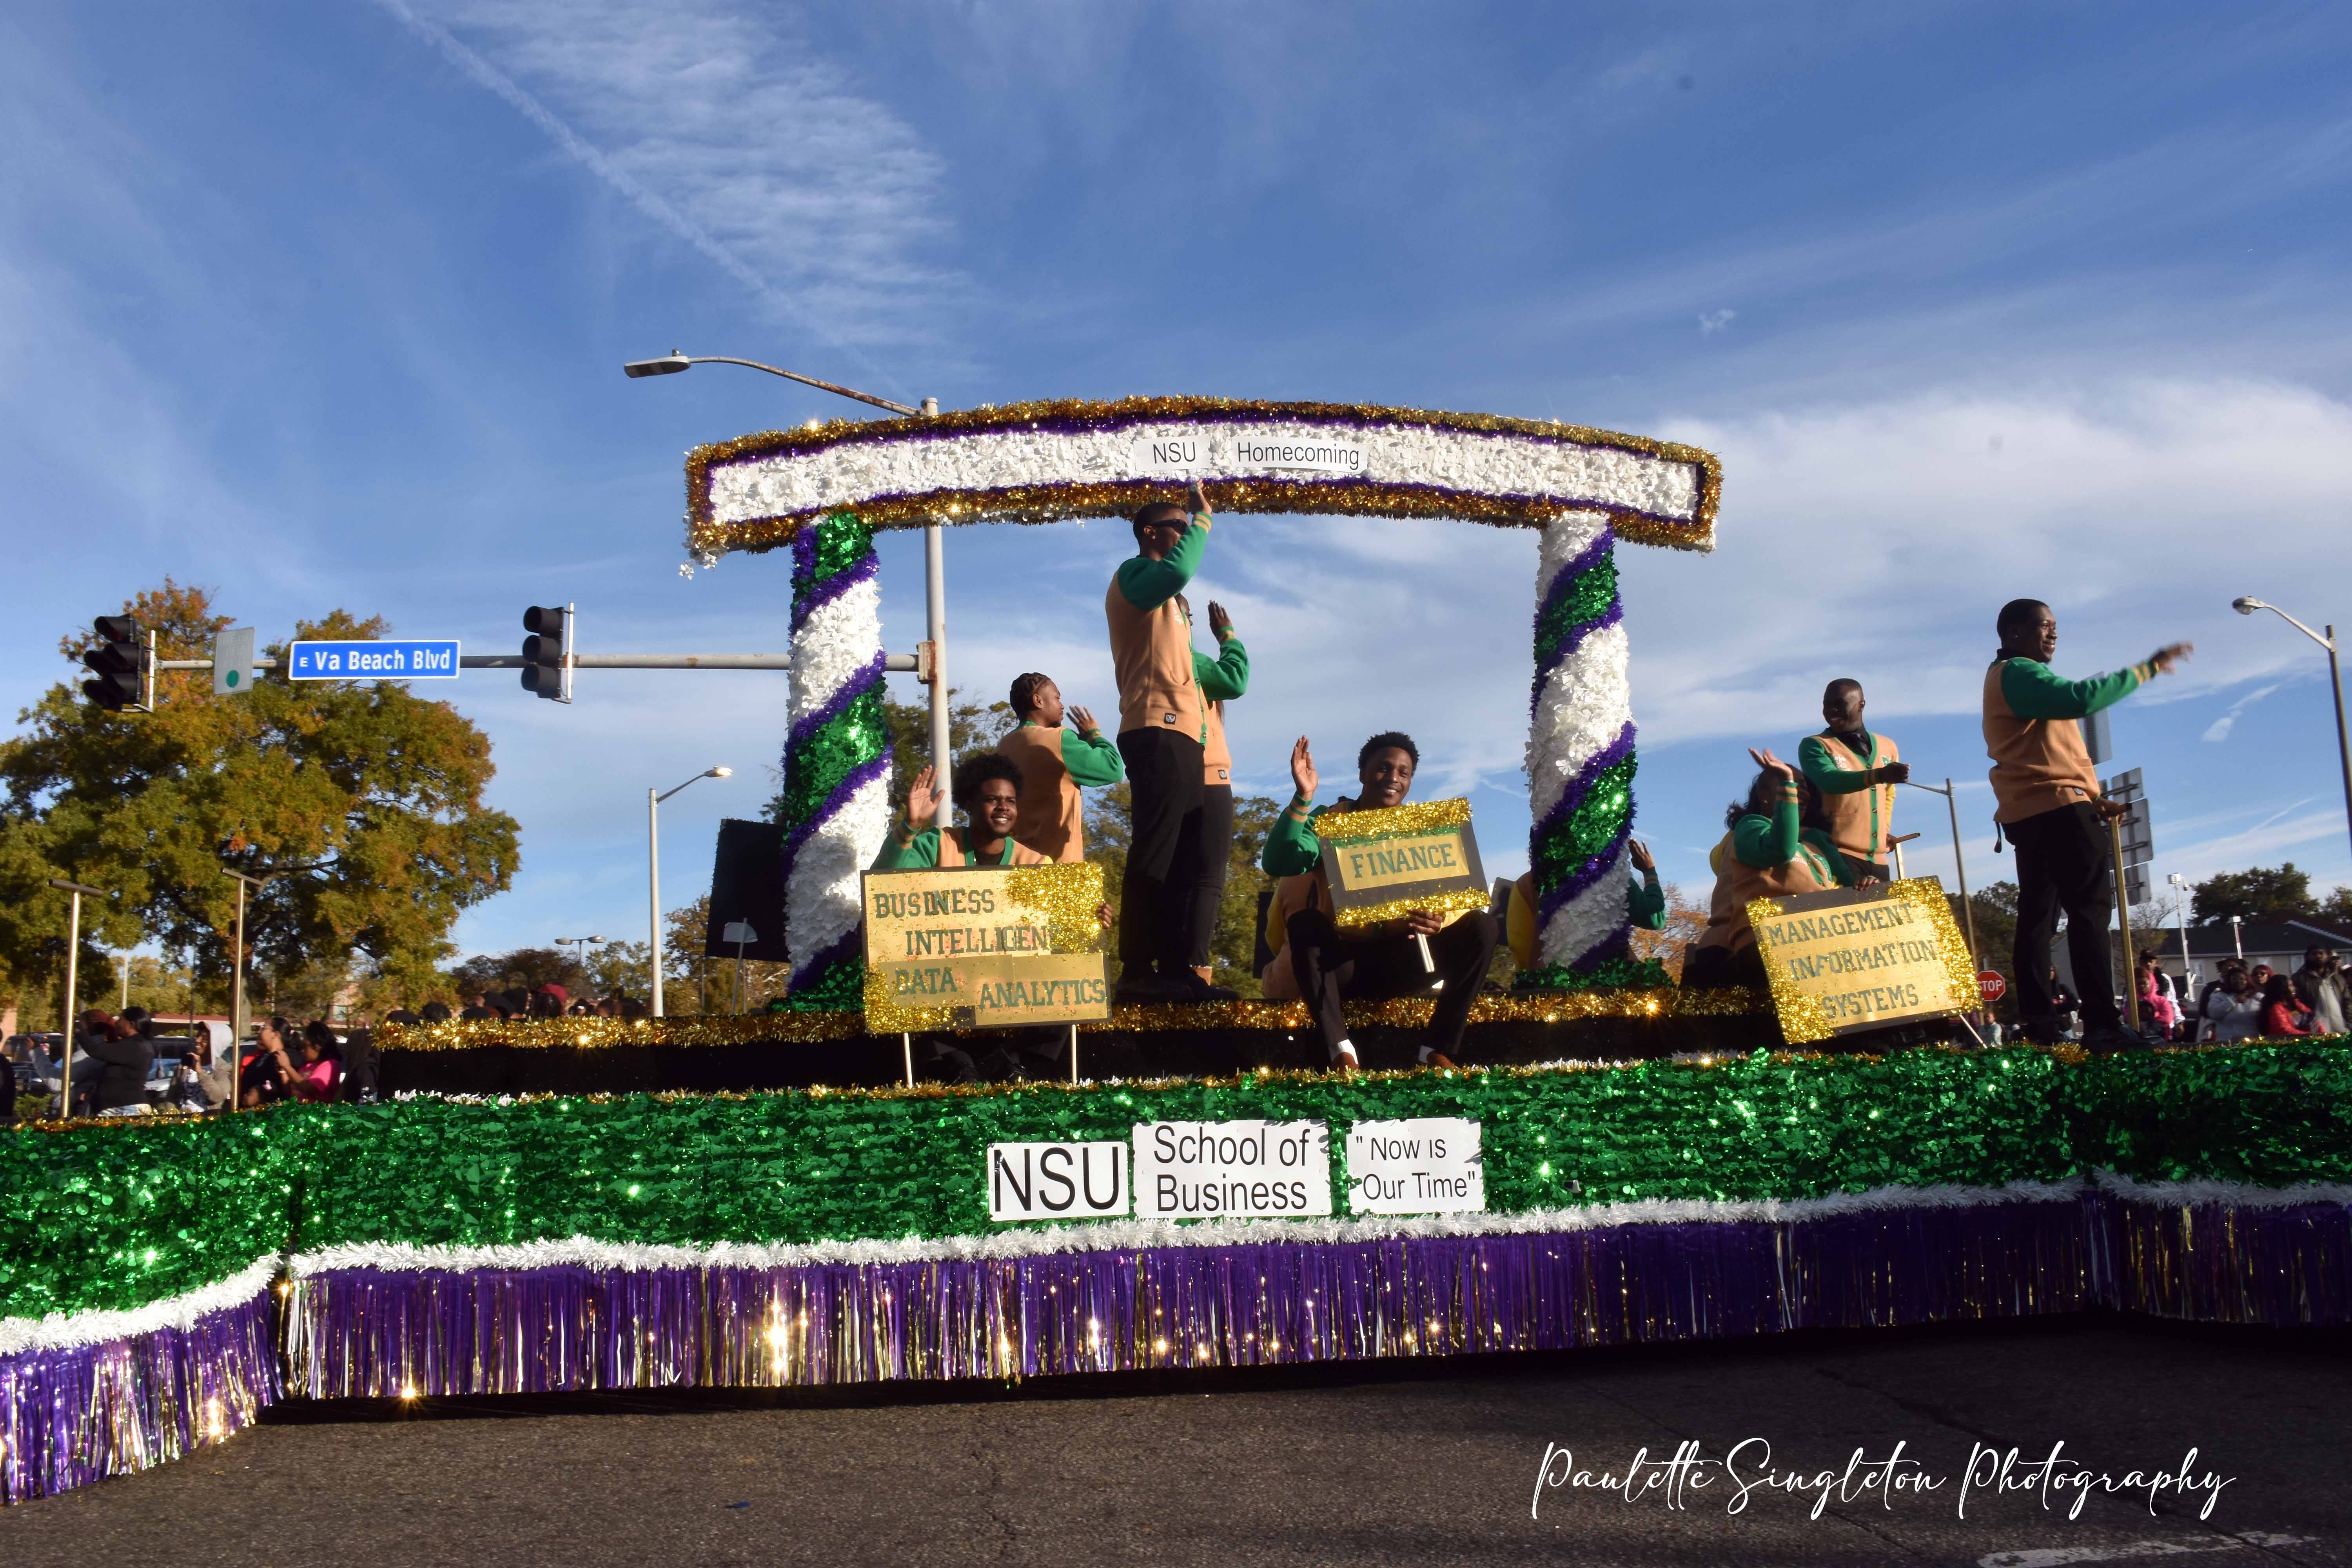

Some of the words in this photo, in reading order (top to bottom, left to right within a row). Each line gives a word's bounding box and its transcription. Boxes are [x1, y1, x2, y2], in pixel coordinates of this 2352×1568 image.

[1153, 441, 1196, 464] NSU
[1238, 441, 1359, 470] Homecoming
[299, 657, 308, 667] E
[315, 651, 340, 670] Va
[348, 649, 404, 670] Beach
[414, 649, 450, 669] Blvd
[1350, 843, 1457, 878] FINANCE
[874, 889, 995, 918] BUSINESS
[1766, 902, 1915, 947] MANAGEMENT
[1787, 939, 1939, 981] INFORMATION
[895, 966, 957, 995] DATA
[980, 978, 1106, 1009] ANALYTICS
[1820, 983, 1919, 1019] SYSTEMS
[1154, 1125, 1265, 1166] School
[1279, 1128, 1311, 1166] of
[994, 1146, 1119, 1212] NSU
[1156, 1173, 1307, 1212] Business
[1363, 1173, 1405, 1200] Our
[1412, 1170, 1475, 1198] Time"
